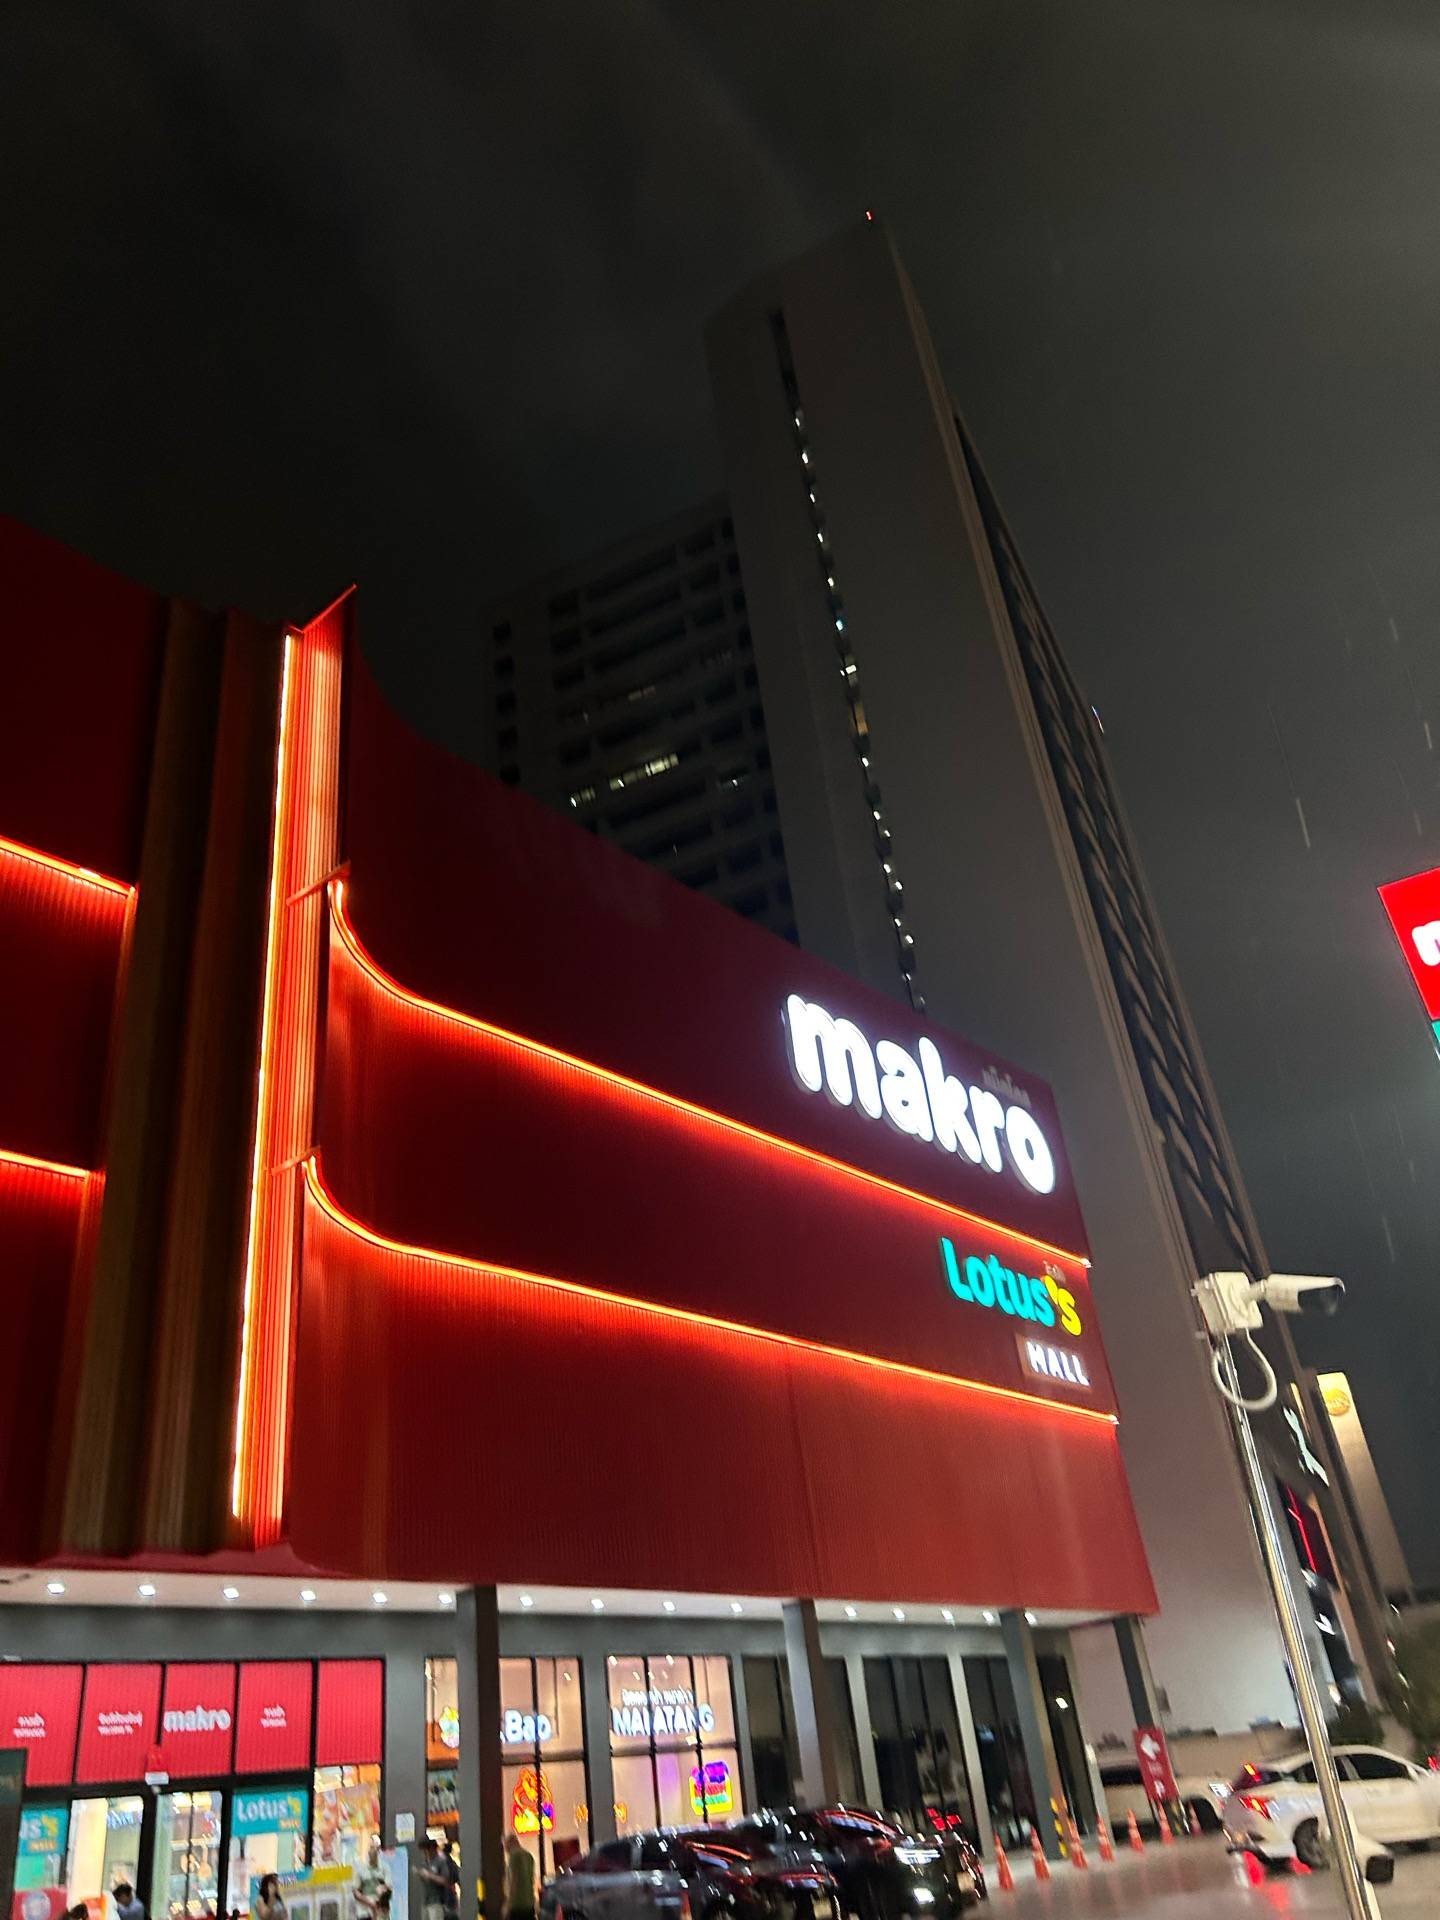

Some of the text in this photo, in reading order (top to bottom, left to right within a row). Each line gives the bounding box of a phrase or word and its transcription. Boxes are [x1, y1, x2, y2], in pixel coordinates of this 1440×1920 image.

[786, 993, 1056, 1194] makro
[941, 1237, 1082, 1336] Lotus's
[164, 1704, 231, 1732] makro
